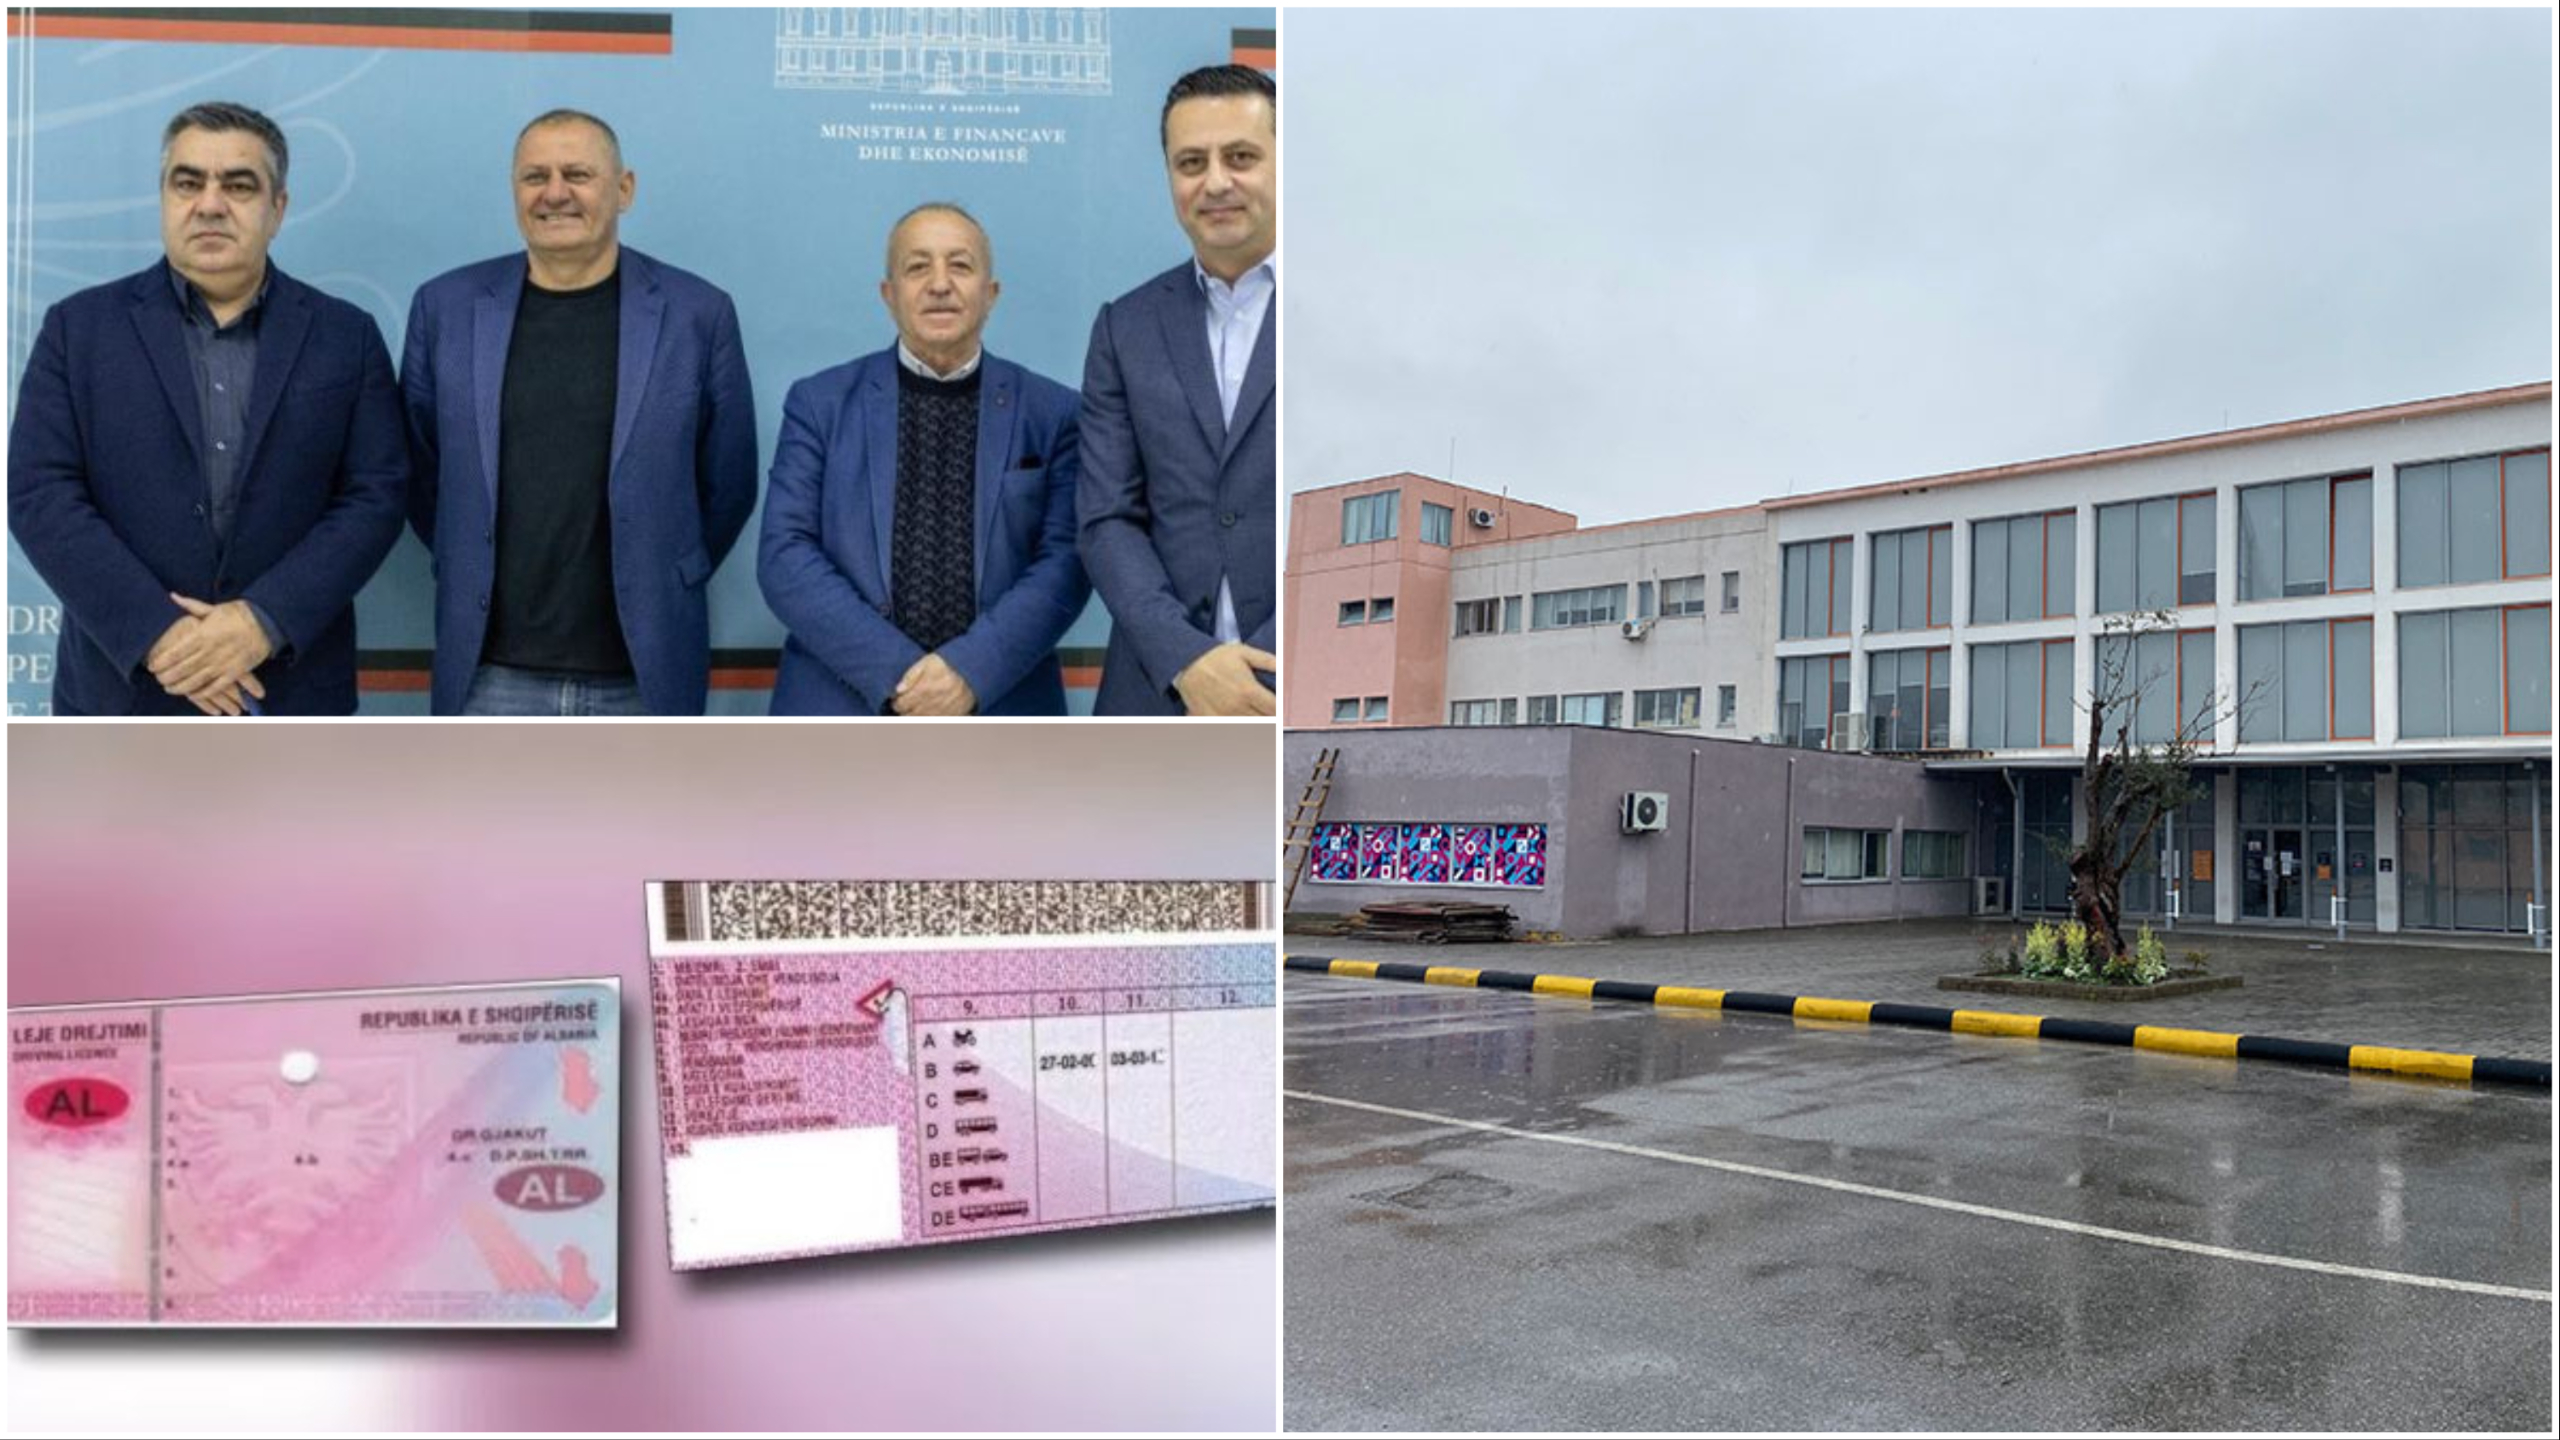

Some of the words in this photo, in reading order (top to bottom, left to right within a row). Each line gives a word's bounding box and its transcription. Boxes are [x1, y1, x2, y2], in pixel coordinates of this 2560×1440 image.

[820, 123, 928, 141] MINISTRIA
[934, 126, 946, 141] E
[953, 126, 1066, 144] FINANCAVE
[859, 145, 902, 160] DHE
[909, 145, 1029, 163] EKONOMISË
[360, 1008, 463, 1029] REPUBLIKA
[467, 1007, 480, 1025] E
[484, 998, 599, 1024] SHQIPËRISË
[963, 1000, 979, 1016] 9.
[1058, 996, 1082, 1012] 10.
[12, 1027, 54, 1044] LEJE
[60, 1022, 148, 1042] DREJTIMI
[457, 1032, 519, 1045] REPUBLIC
[522, 1031, 541, 1043] OF
[543, 1028, 598, 1042] ALBANIA
[923, 1033, 936, 1048] A
[12, 1050, 64, 1063] DRIVING
[925, 1063, 937, 1079] B
[46, 1088, 107, 1120] AL
[925, 1092, 938, 1108] C
[927, 1123, 939, 1139] D
[929, 1151, 953, 1169] BE
[515, 1173, 584, 1204] AL
[930, 1180, 954, 1198] CE
[931, 1209, 955, 1227] DE
